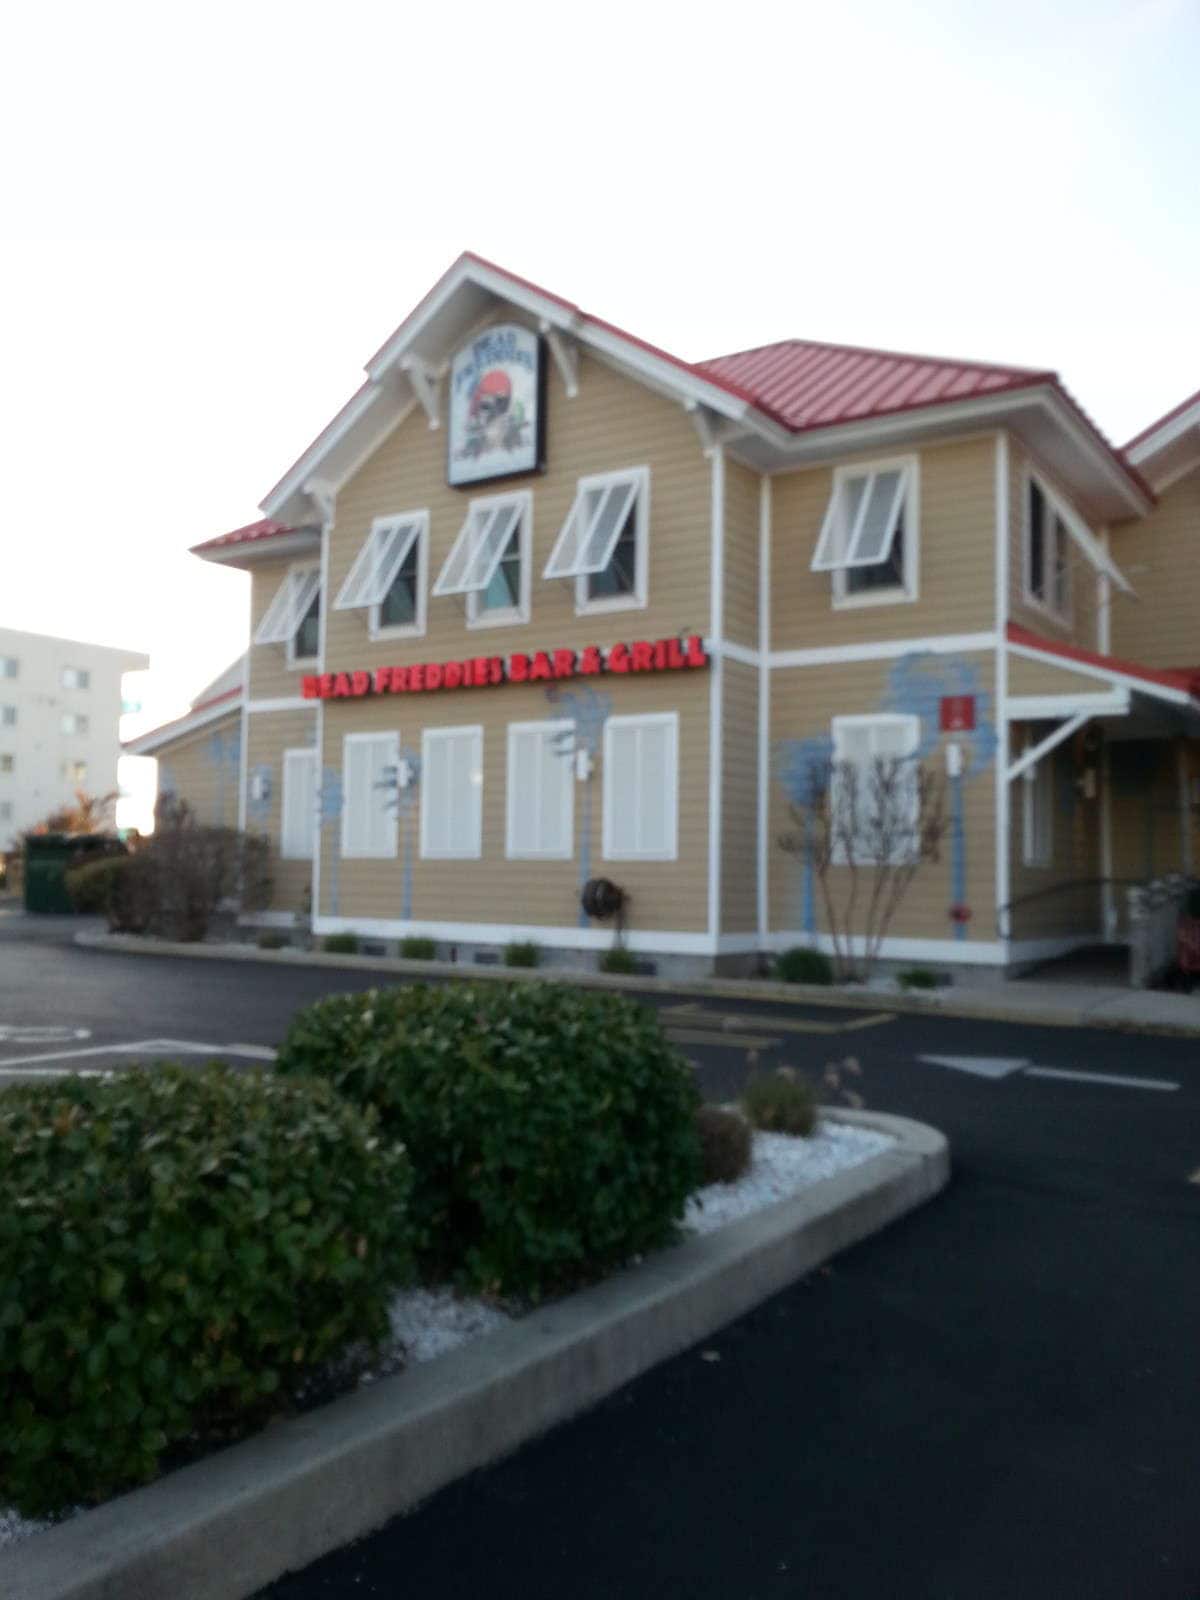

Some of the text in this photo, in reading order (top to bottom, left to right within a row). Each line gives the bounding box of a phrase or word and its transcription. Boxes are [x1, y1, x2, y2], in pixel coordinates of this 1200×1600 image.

[509, 648, 575, 683] BAR
[580, 646, 601, 675] &
[608, 635, 706, 674] GRILL
